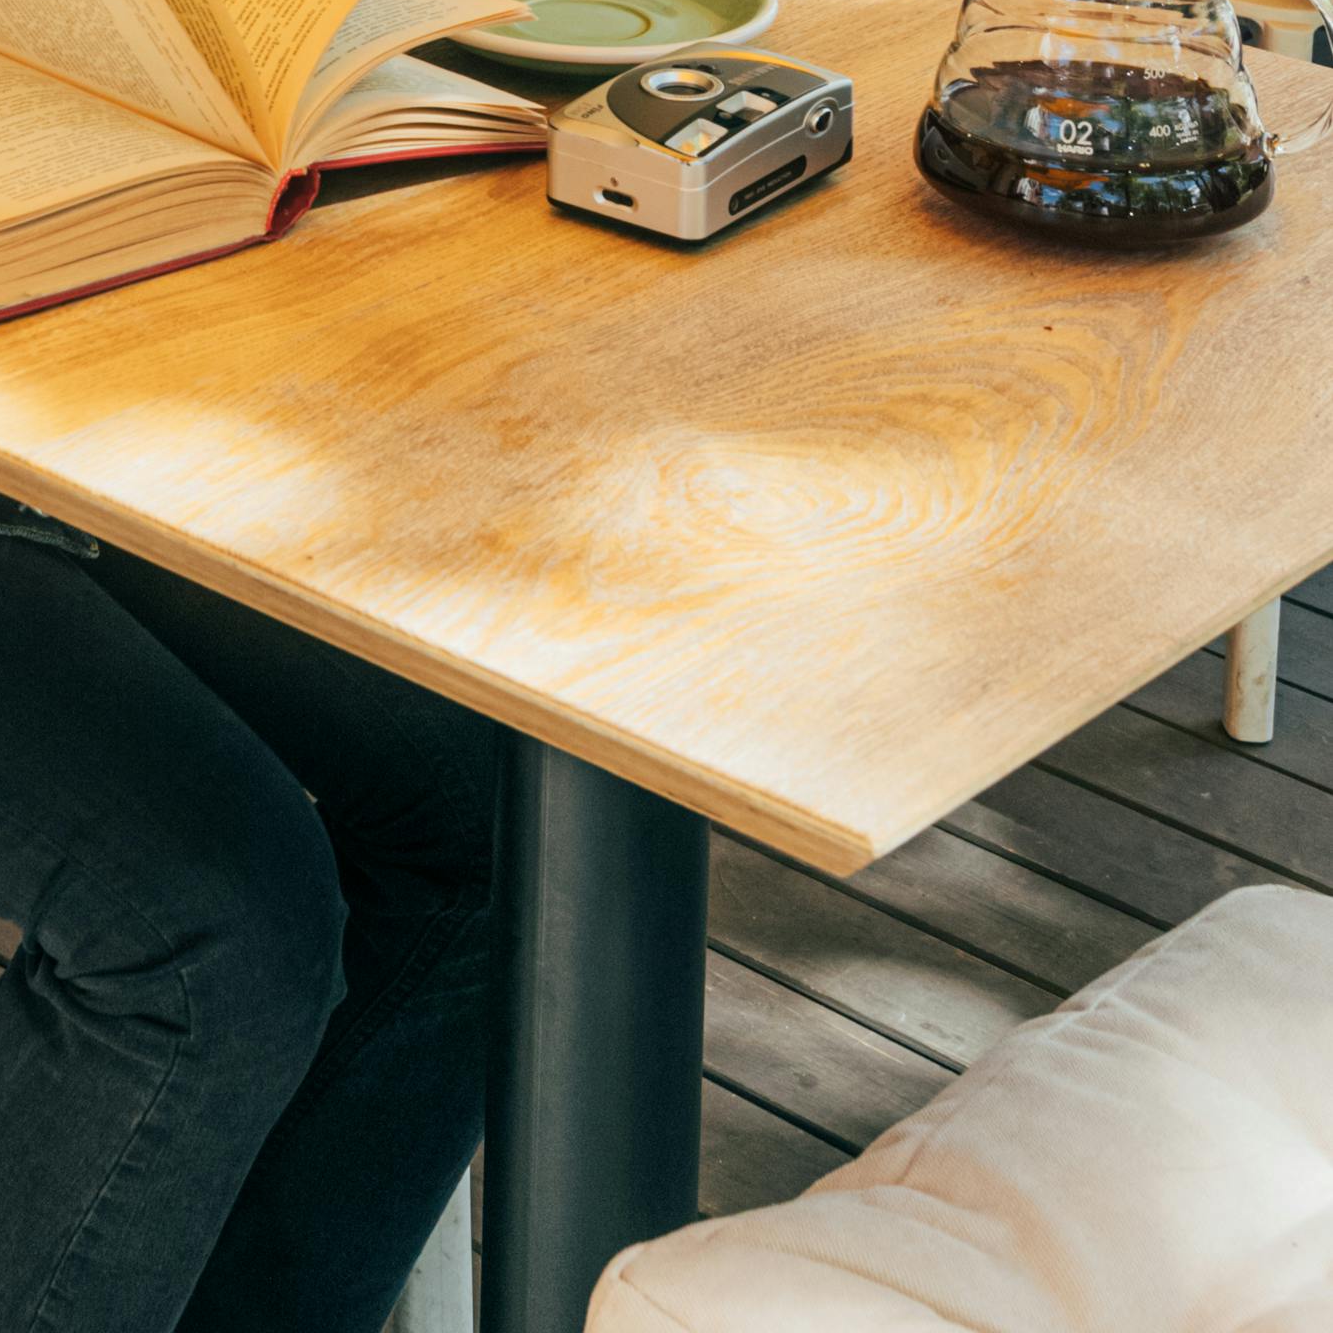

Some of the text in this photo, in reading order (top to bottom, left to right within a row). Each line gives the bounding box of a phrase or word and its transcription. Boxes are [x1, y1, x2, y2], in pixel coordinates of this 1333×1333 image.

[1143, 68, 1165, 80] 500
[1059, 119, 1093, 146] 02
[1149, 124, 1171, 138] 400
[1056, 143, 1094, 156] HARIO
